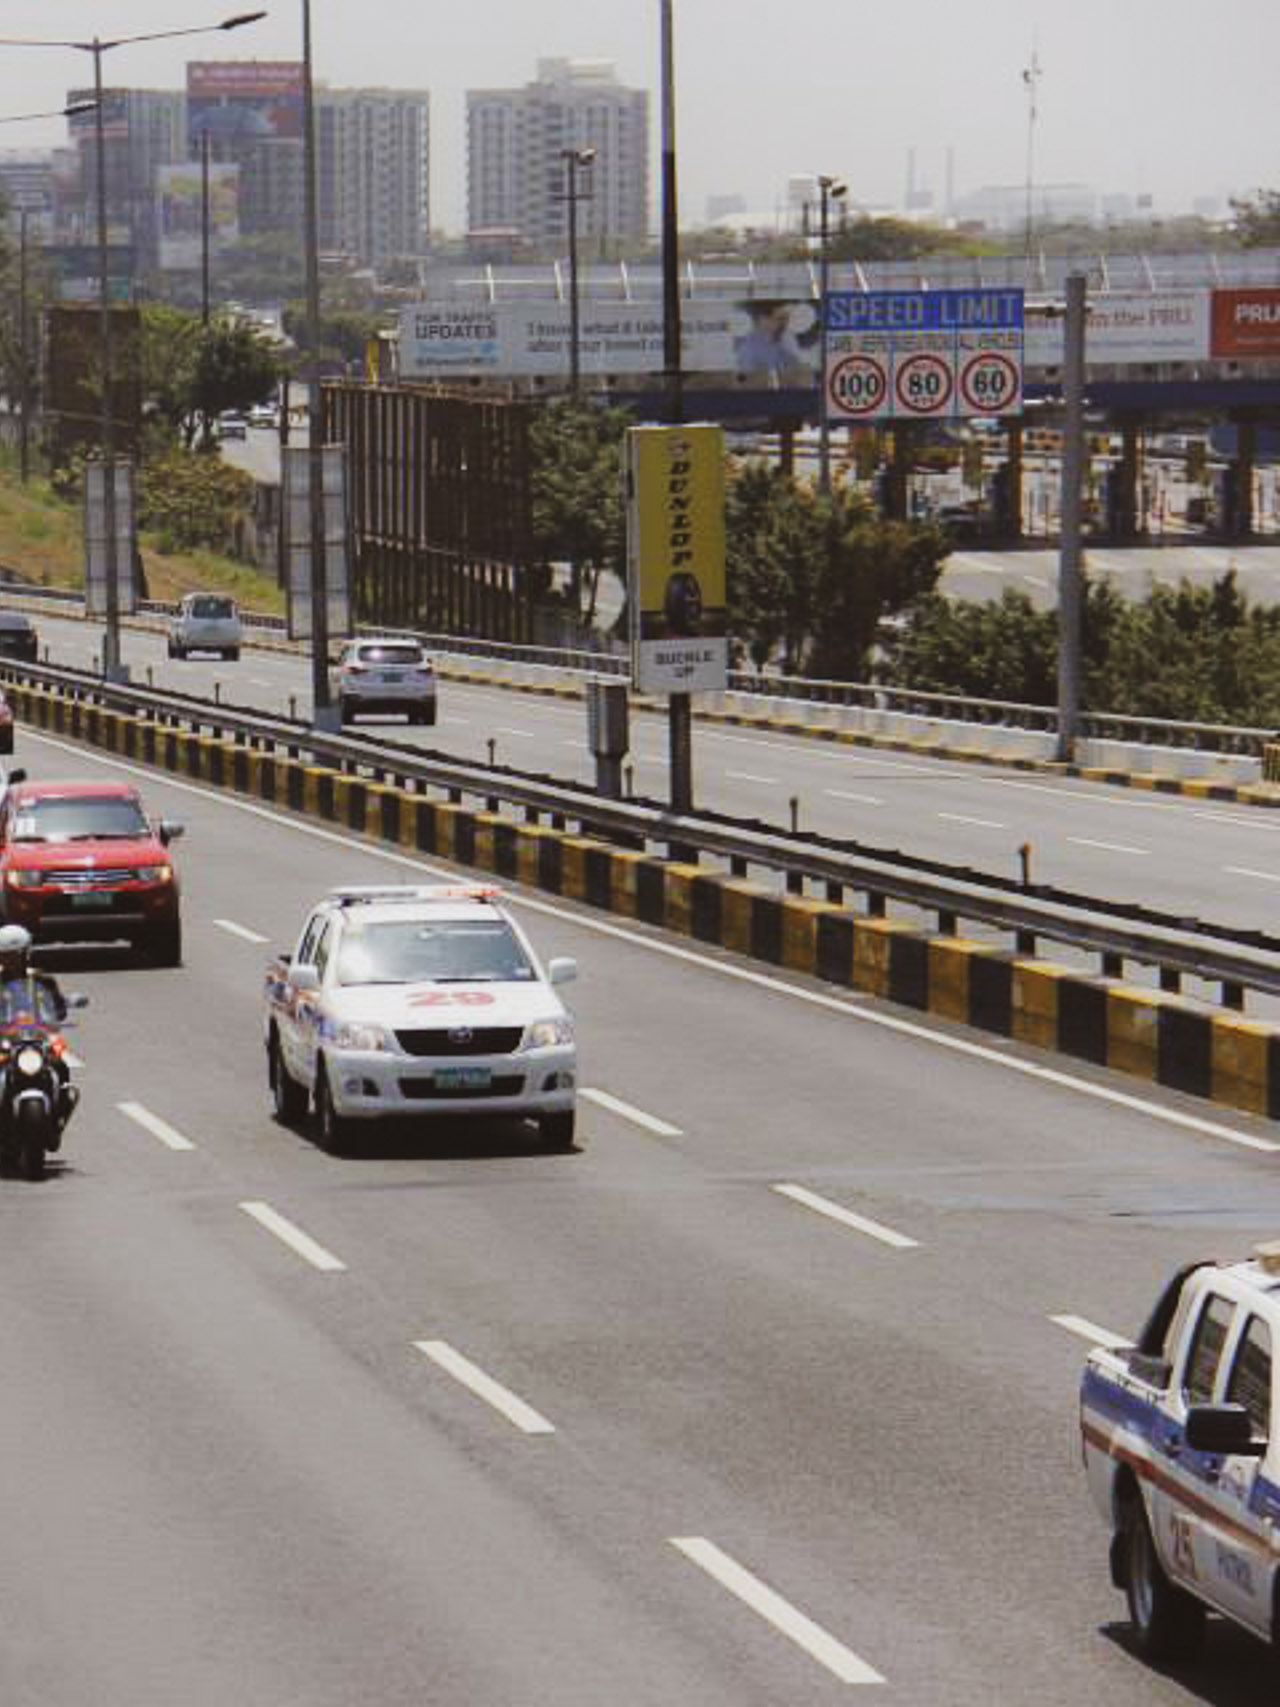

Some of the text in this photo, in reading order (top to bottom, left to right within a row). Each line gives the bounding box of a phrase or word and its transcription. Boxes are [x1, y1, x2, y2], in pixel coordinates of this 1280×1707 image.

[829, 297, 923, 326] SPEED
[941, 293, 1017, 322] LIMIT
[416, 324, 497, 339] UPDATES
[838, 374, 879, 398] 100
[909, 373, 940, 396] 80
[973, 370, 1006, 394] 60
[669, 461, 693, 567] DUNLOP
[405, 991, 494, 1008] 29
